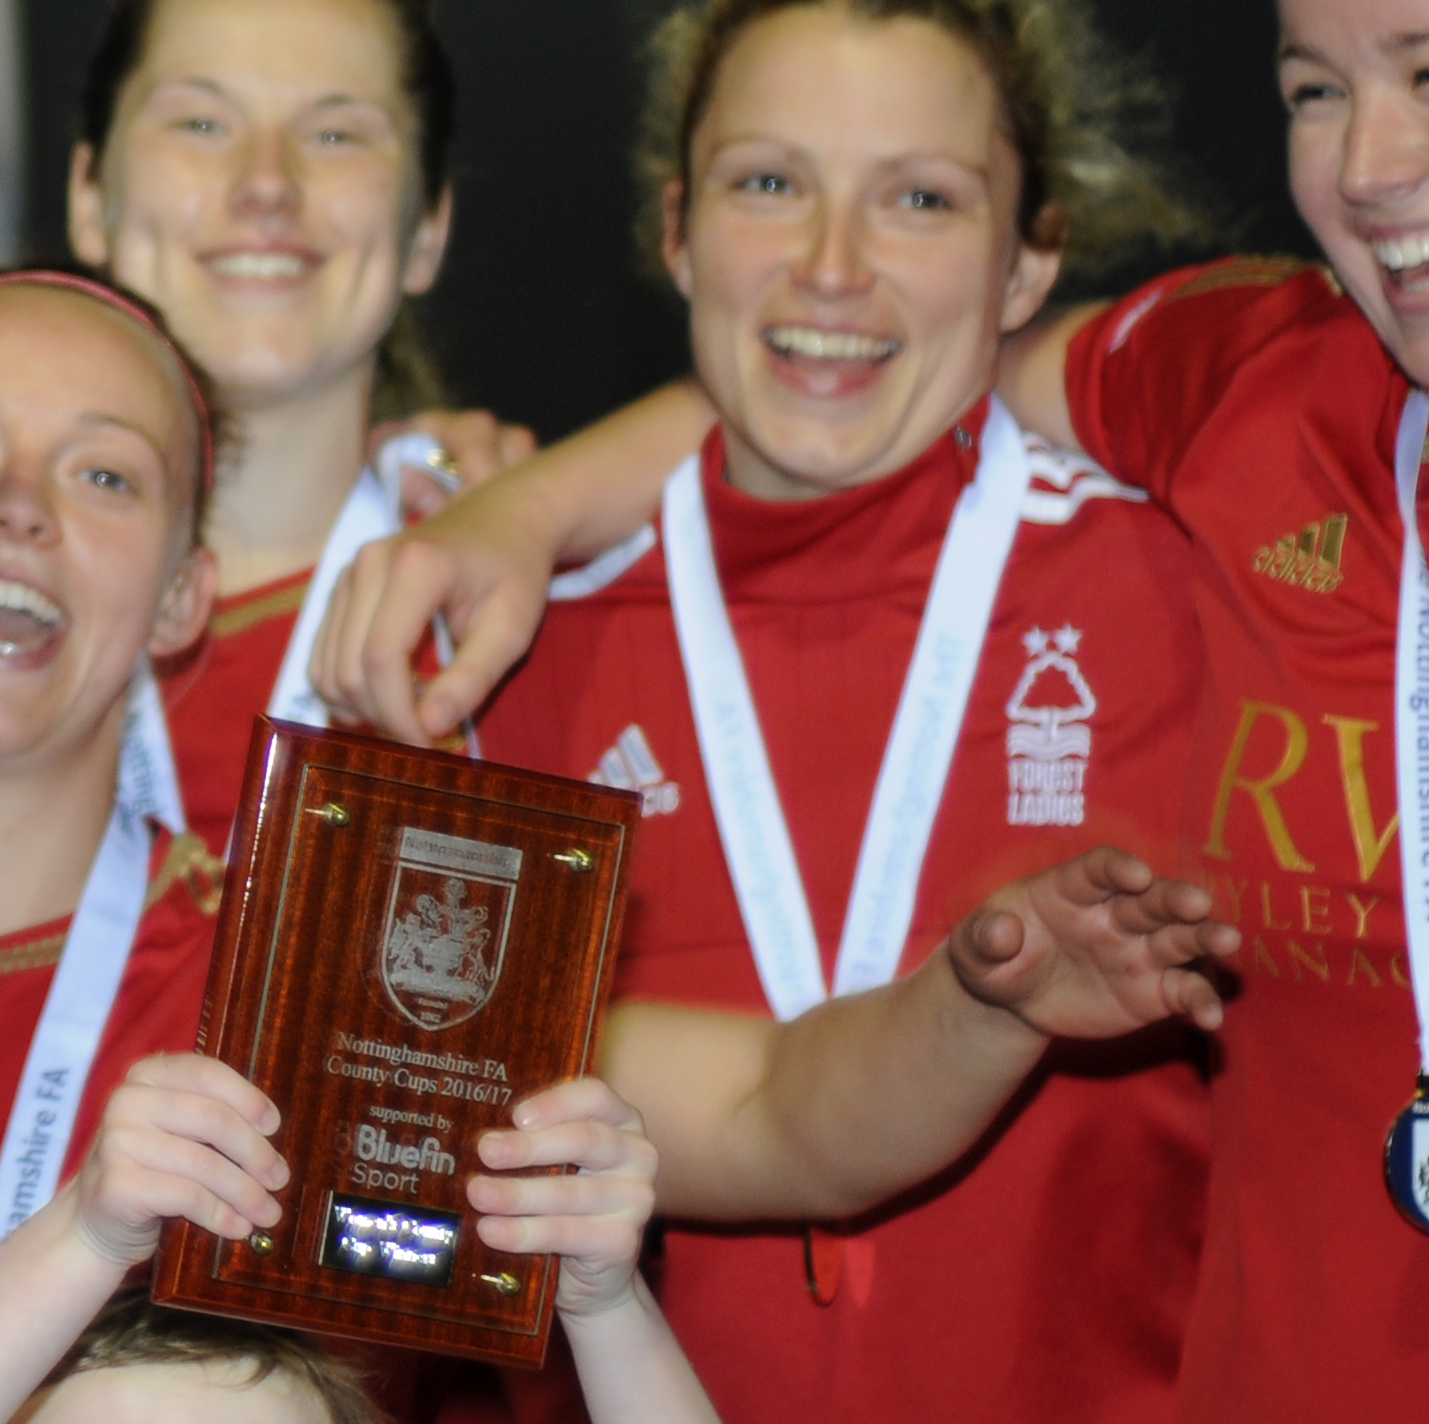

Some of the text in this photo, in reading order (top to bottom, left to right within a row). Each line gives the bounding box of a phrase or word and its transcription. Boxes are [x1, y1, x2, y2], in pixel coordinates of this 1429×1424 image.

[337, 1031, 509, 1082] Nottinghamshire FA
[34, 1066, 72, 1102] FA
[326, 1055, 513, 1107] County Cups 2016/17
[369, 1104, 455, 1134] supported by
[356, 1123, 456, 1176] Bluefin
[351, 1162, 421, 1194] Sport
